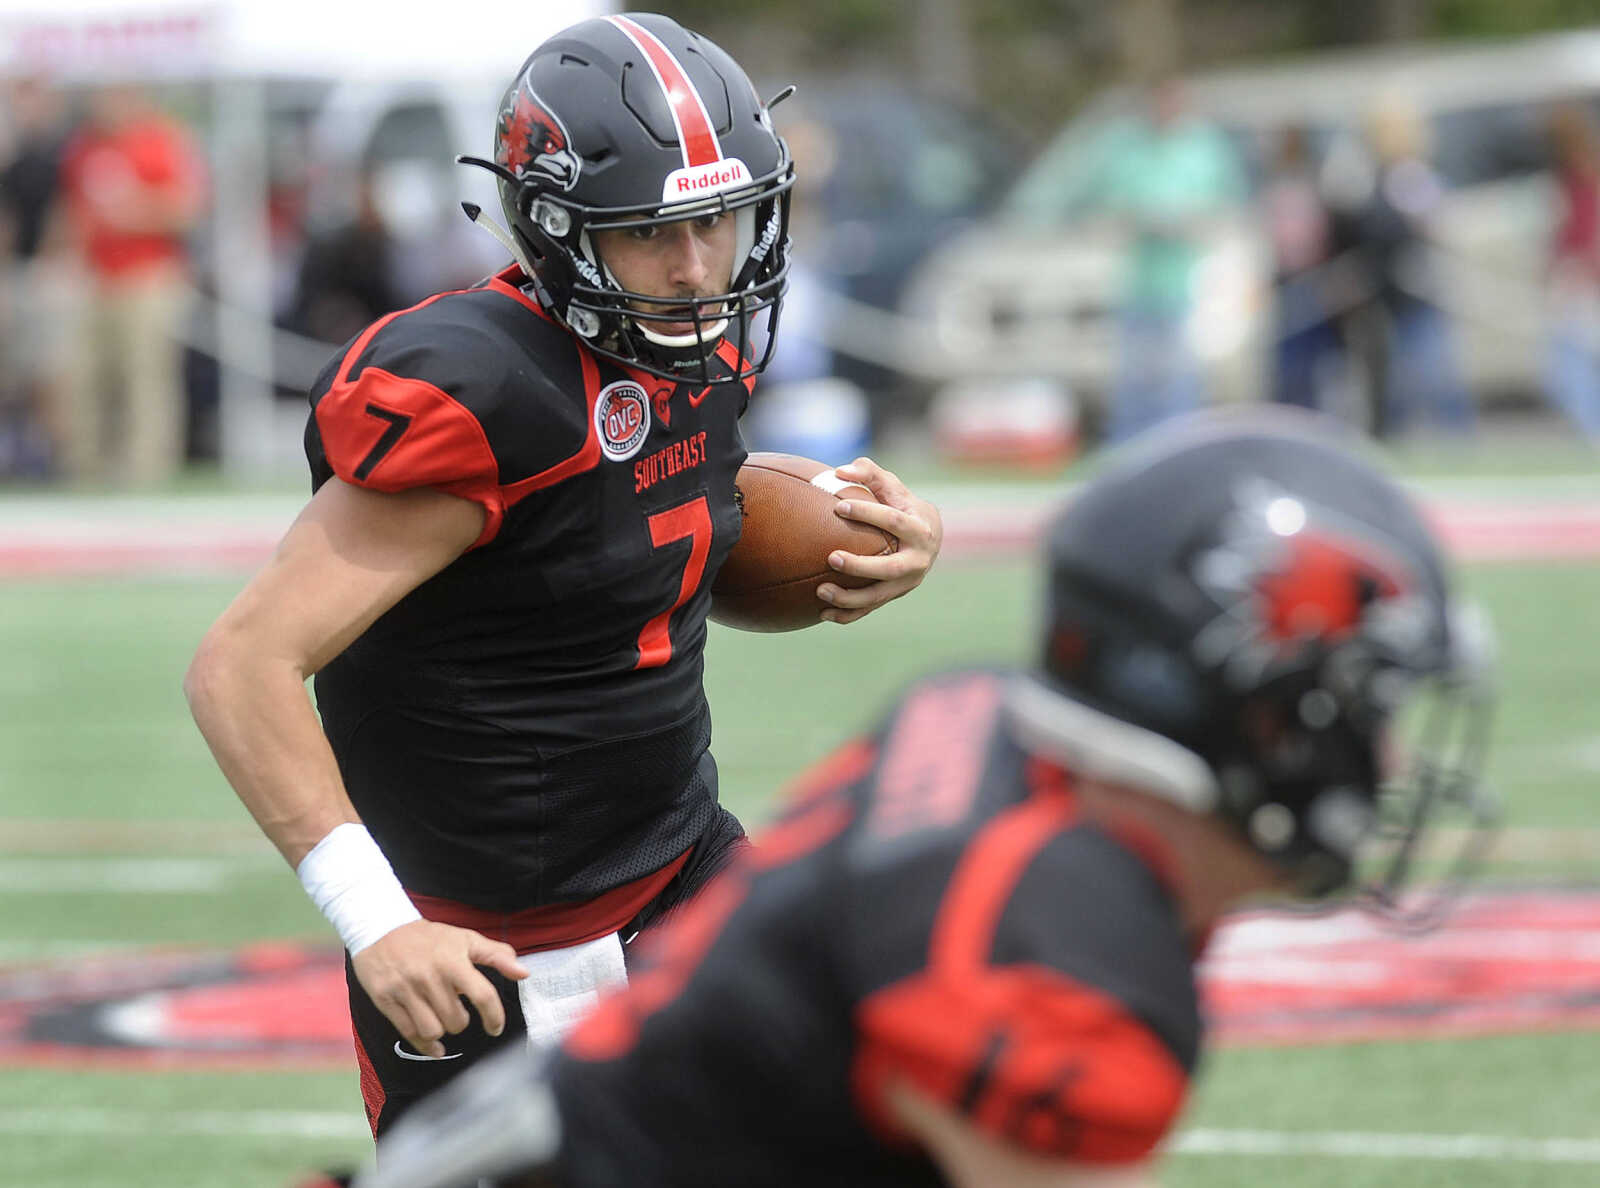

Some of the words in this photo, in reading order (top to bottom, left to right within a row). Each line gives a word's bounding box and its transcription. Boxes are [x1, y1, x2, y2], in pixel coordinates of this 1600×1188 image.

[676, 165, 741, 192] Riddell
[353, 403, 412, 482] 7
[609, 403, 637, 438] OVC
[634, 431, 707, 494] SOUTHEAST
[634, 495, 713, 670] 7
